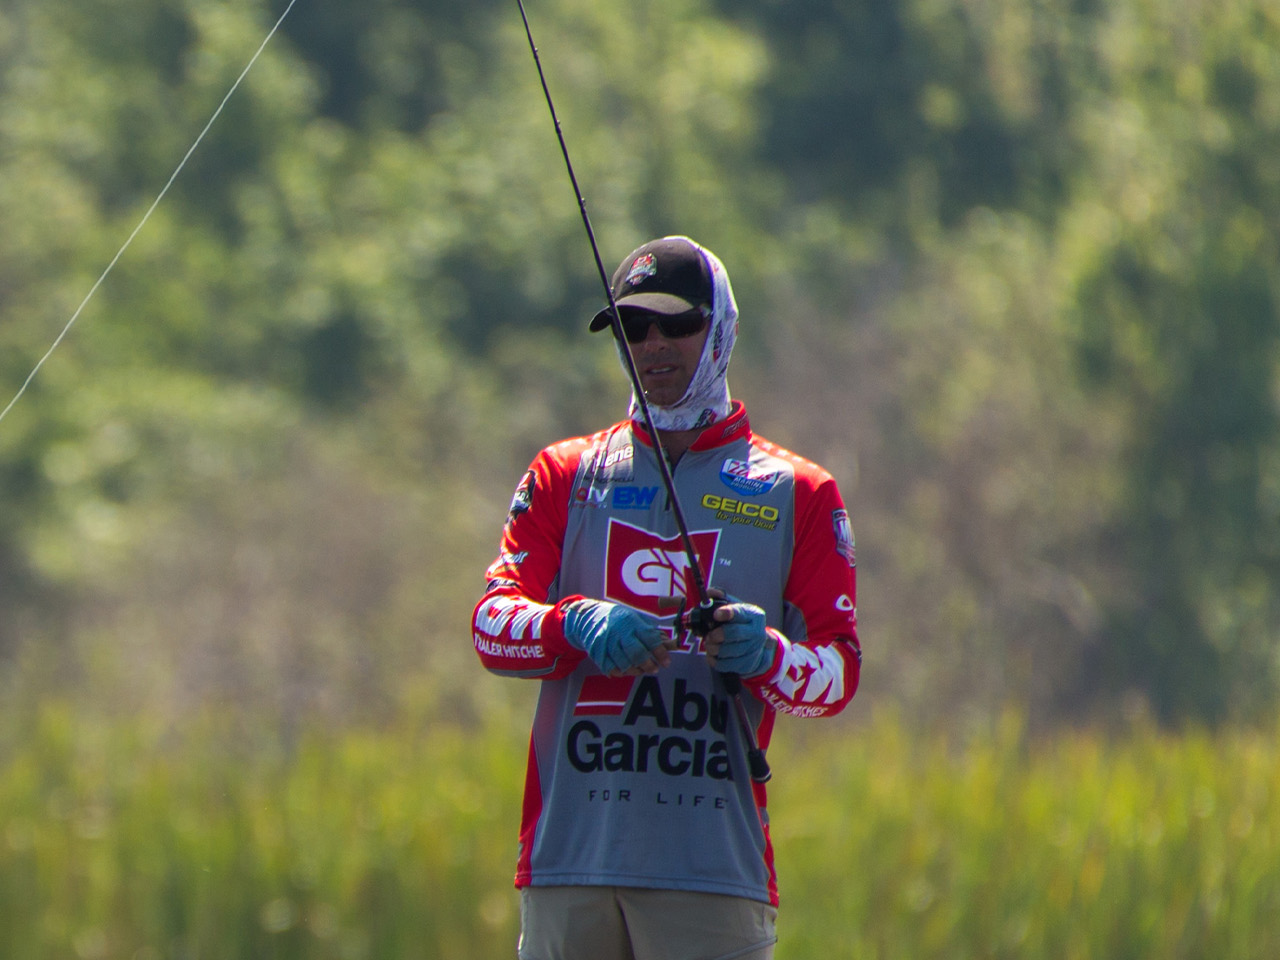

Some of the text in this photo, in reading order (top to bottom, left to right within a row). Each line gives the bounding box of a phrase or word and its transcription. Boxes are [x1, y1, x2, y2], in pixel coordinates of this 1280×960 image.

[702, 494, 779, 521] GEICO
[621, 547, 700, 597] GT
[623, 676, 728, 735] Abu
[567, 720, 734, 782] Garcia
[589, 790, 728, 809] FOR LIFE
